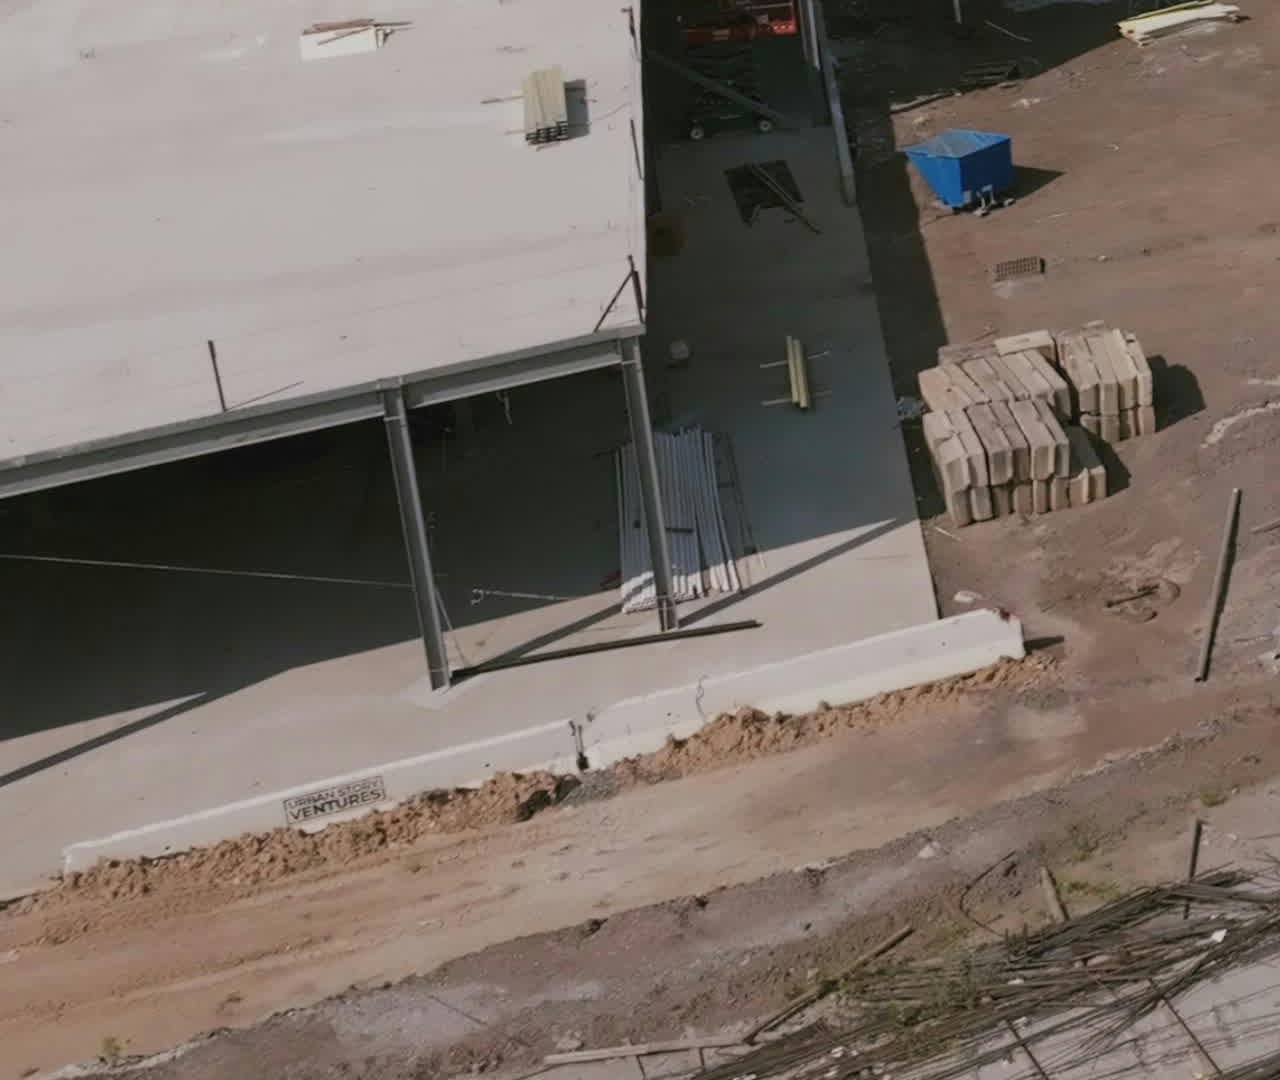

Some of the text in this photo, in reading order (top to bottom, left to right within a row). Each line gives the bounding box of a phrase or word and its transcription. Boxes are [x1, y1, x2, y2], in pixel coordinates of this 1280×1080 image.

[288, 778, 379, 809] URBAN STORY
[289, 789, 381, 820] VENTURES
